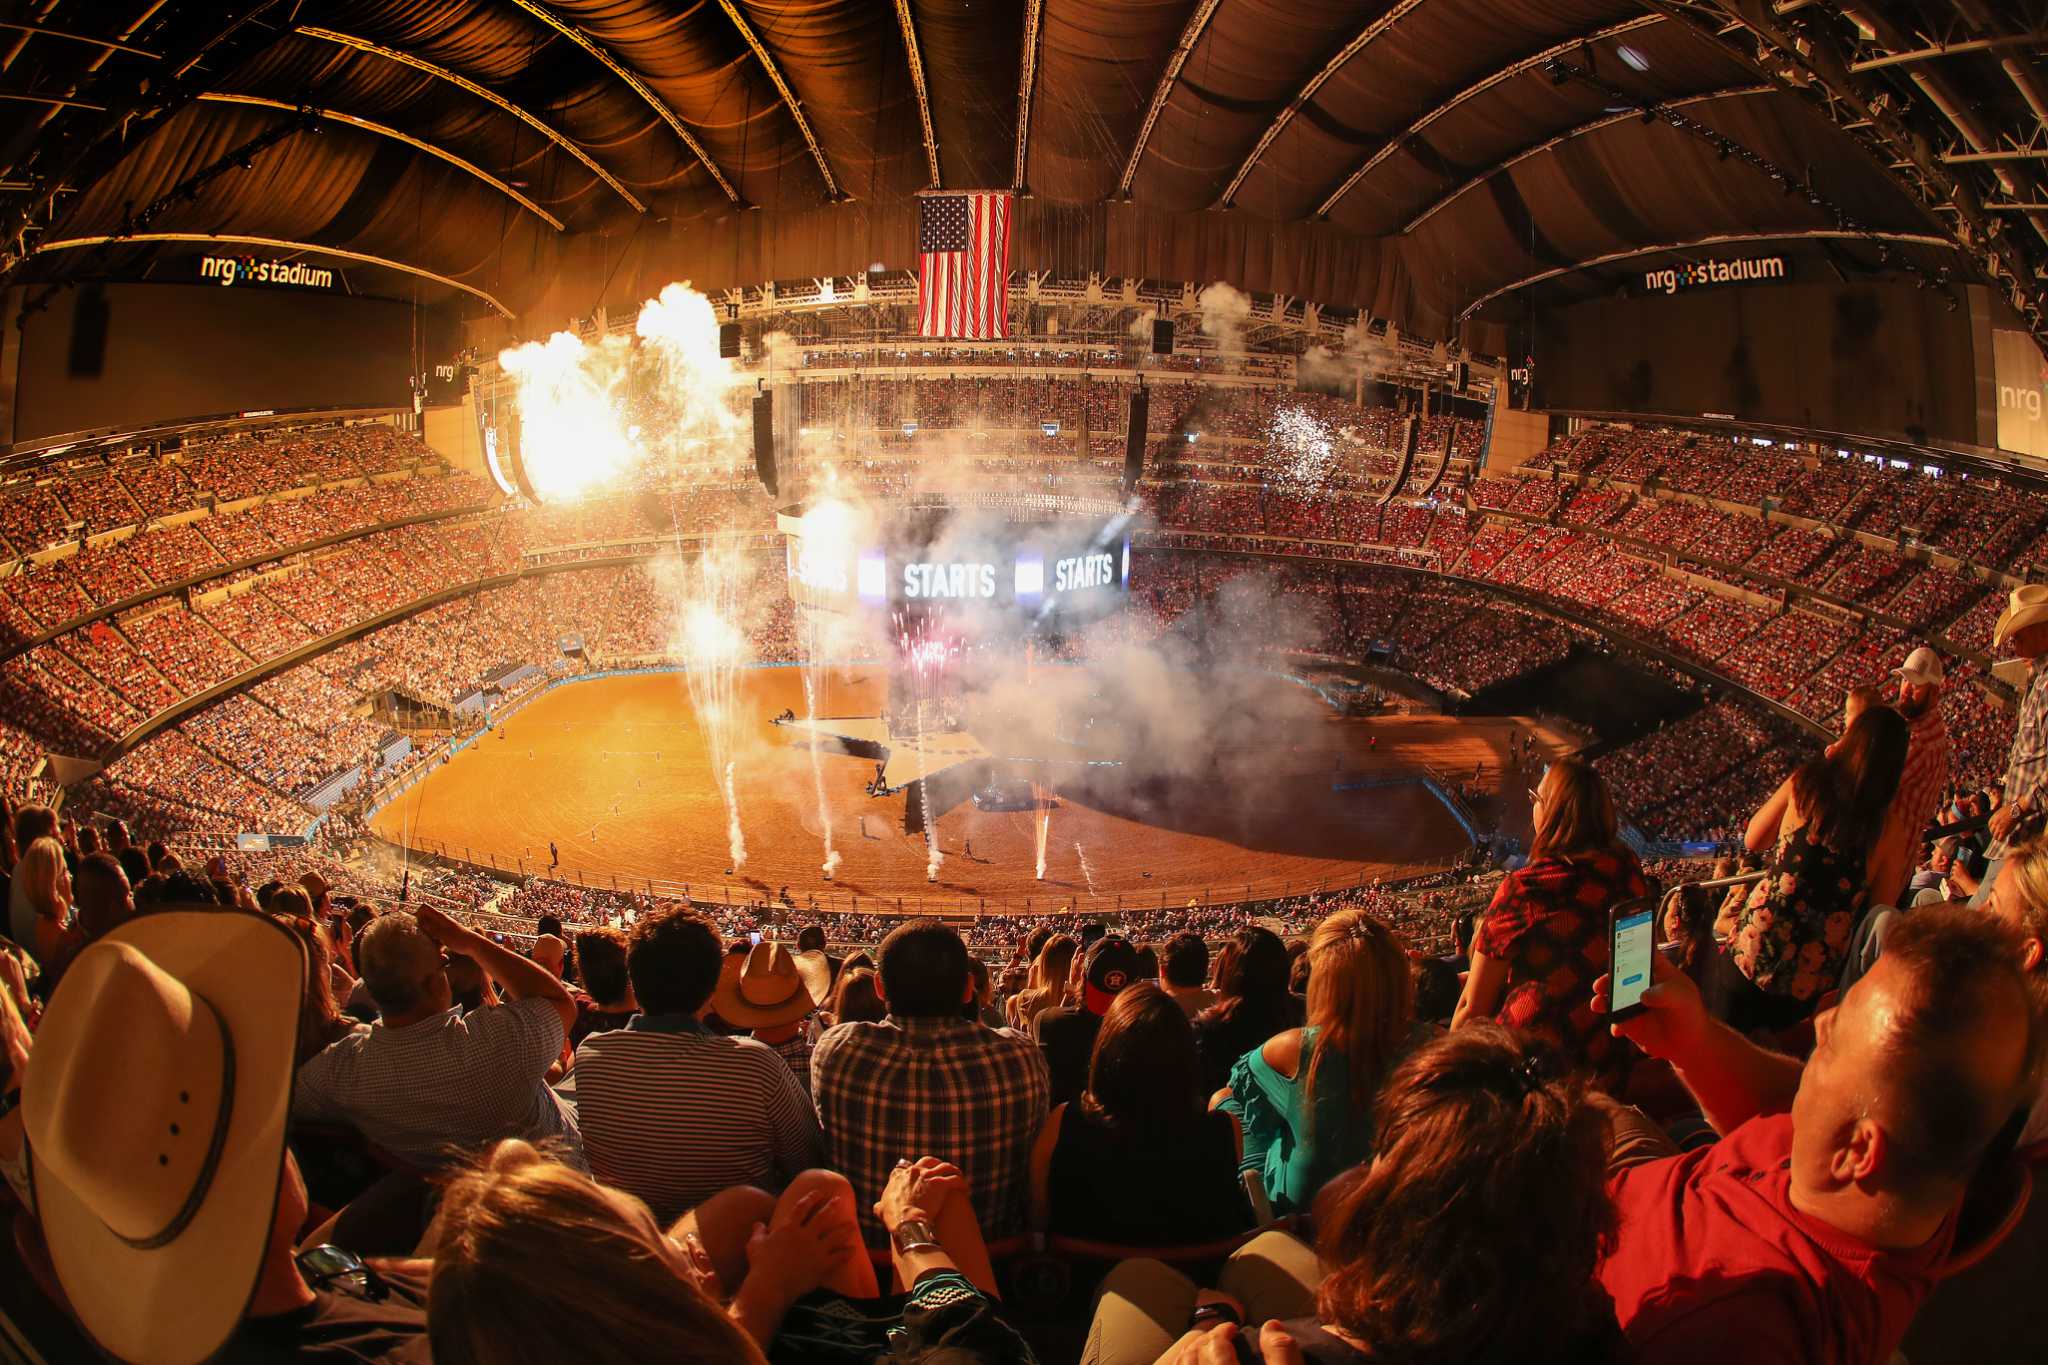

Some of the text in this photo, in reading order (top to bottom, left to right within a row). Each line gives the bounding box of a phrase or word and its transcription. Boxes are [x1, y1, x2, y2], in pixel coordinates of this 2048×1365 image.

[201, 257, 332, 288] nrg stadium
[1645, 256, 1785, 294] nrg stadium
[435, 364, 454, 383] nrg
[1511, 368, 1529, 386] nrg
[2000, 385, 2041, 422] nrg
[903, 563, 996, 599] STARTS
[1055, 553, 1113, 593] STARTS
